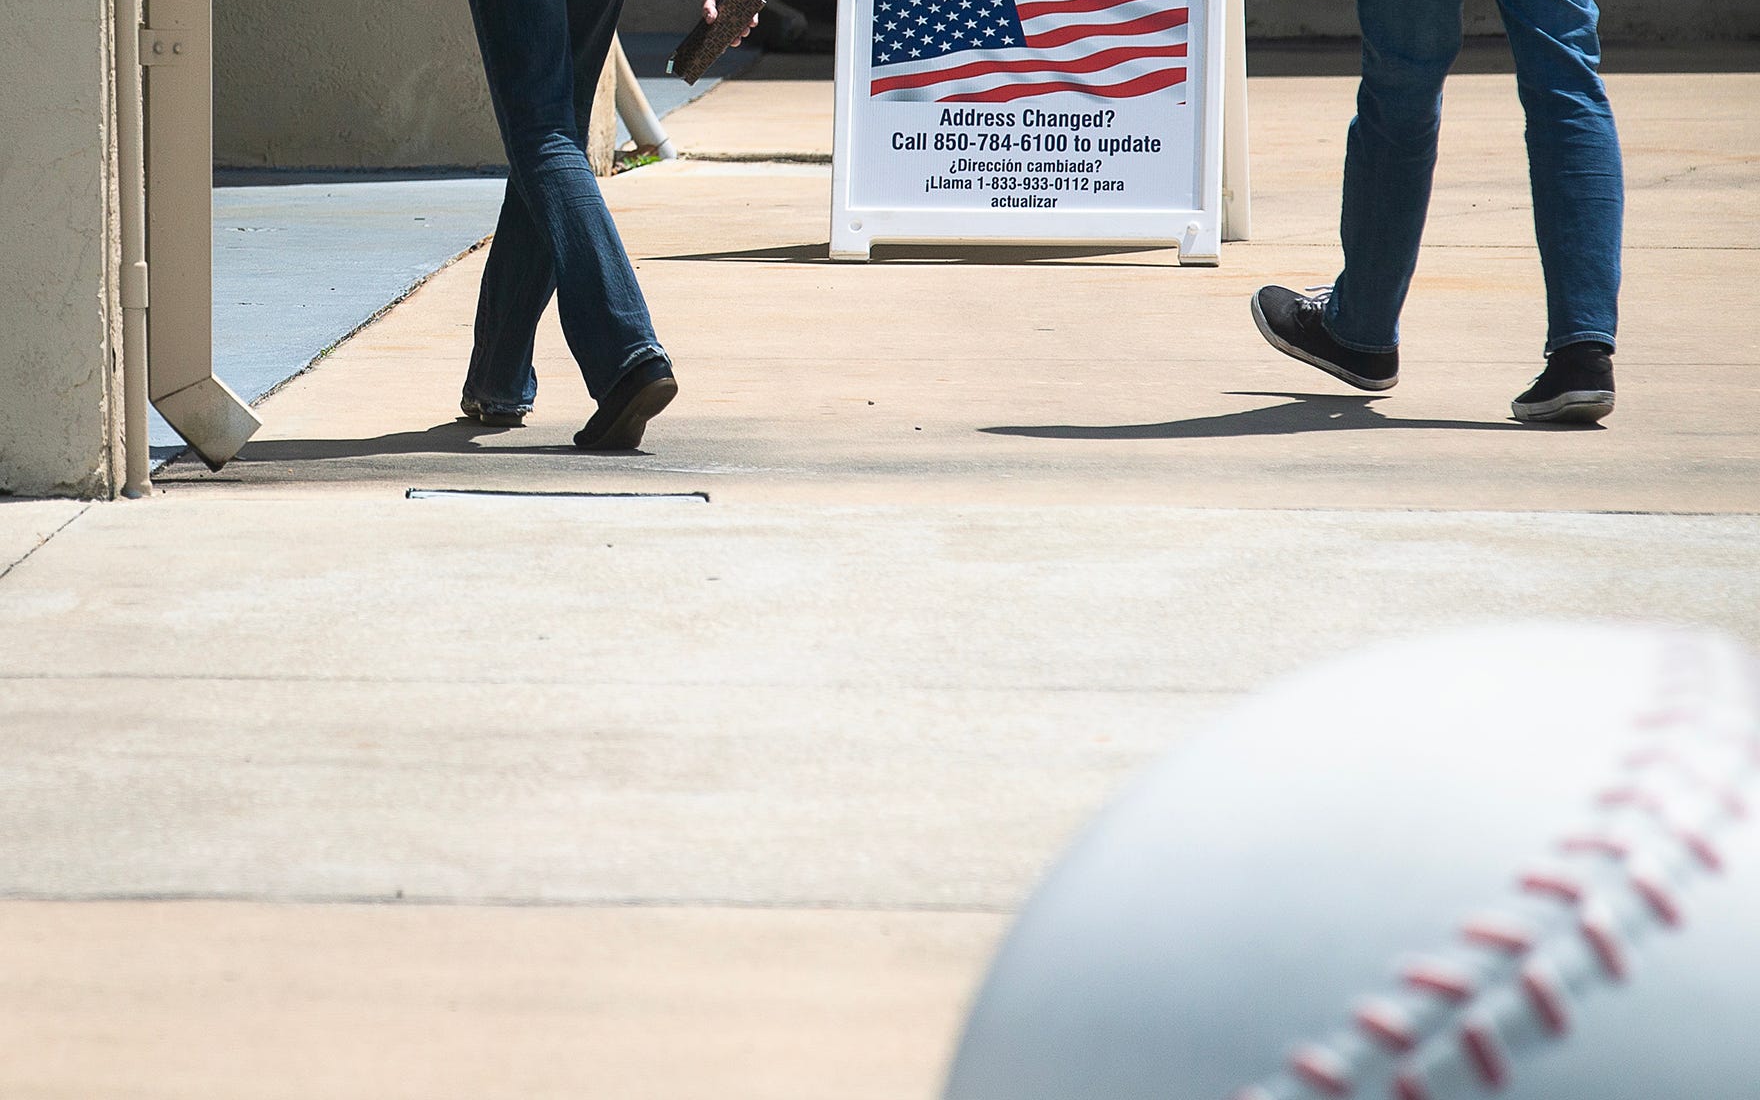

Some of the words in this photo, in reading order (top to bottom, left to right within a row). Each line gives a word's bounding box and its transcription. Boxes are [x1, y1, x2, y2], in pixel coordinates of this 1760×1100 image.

[940, 108, 1015, 127] Address
[1022, 109, 1116, 130] Changed?
[892, 132, 927, 150] Call
[933, 133, 1068, 152] 850-784-6100
[1074, 136, 1091, 153] to
[1098, 135, 1161, 156] update
[949, 158, 1022, 173] ¿Dirección
[1027, 159, 1102, 173] cambiada?
[925, 177, 972, 193] ¡Llama
[977, 177, 1089, 191] 1-833-933-0112
[1093, 179, 1125, 193] para
[991, 194, 1058, 208] actualizar
